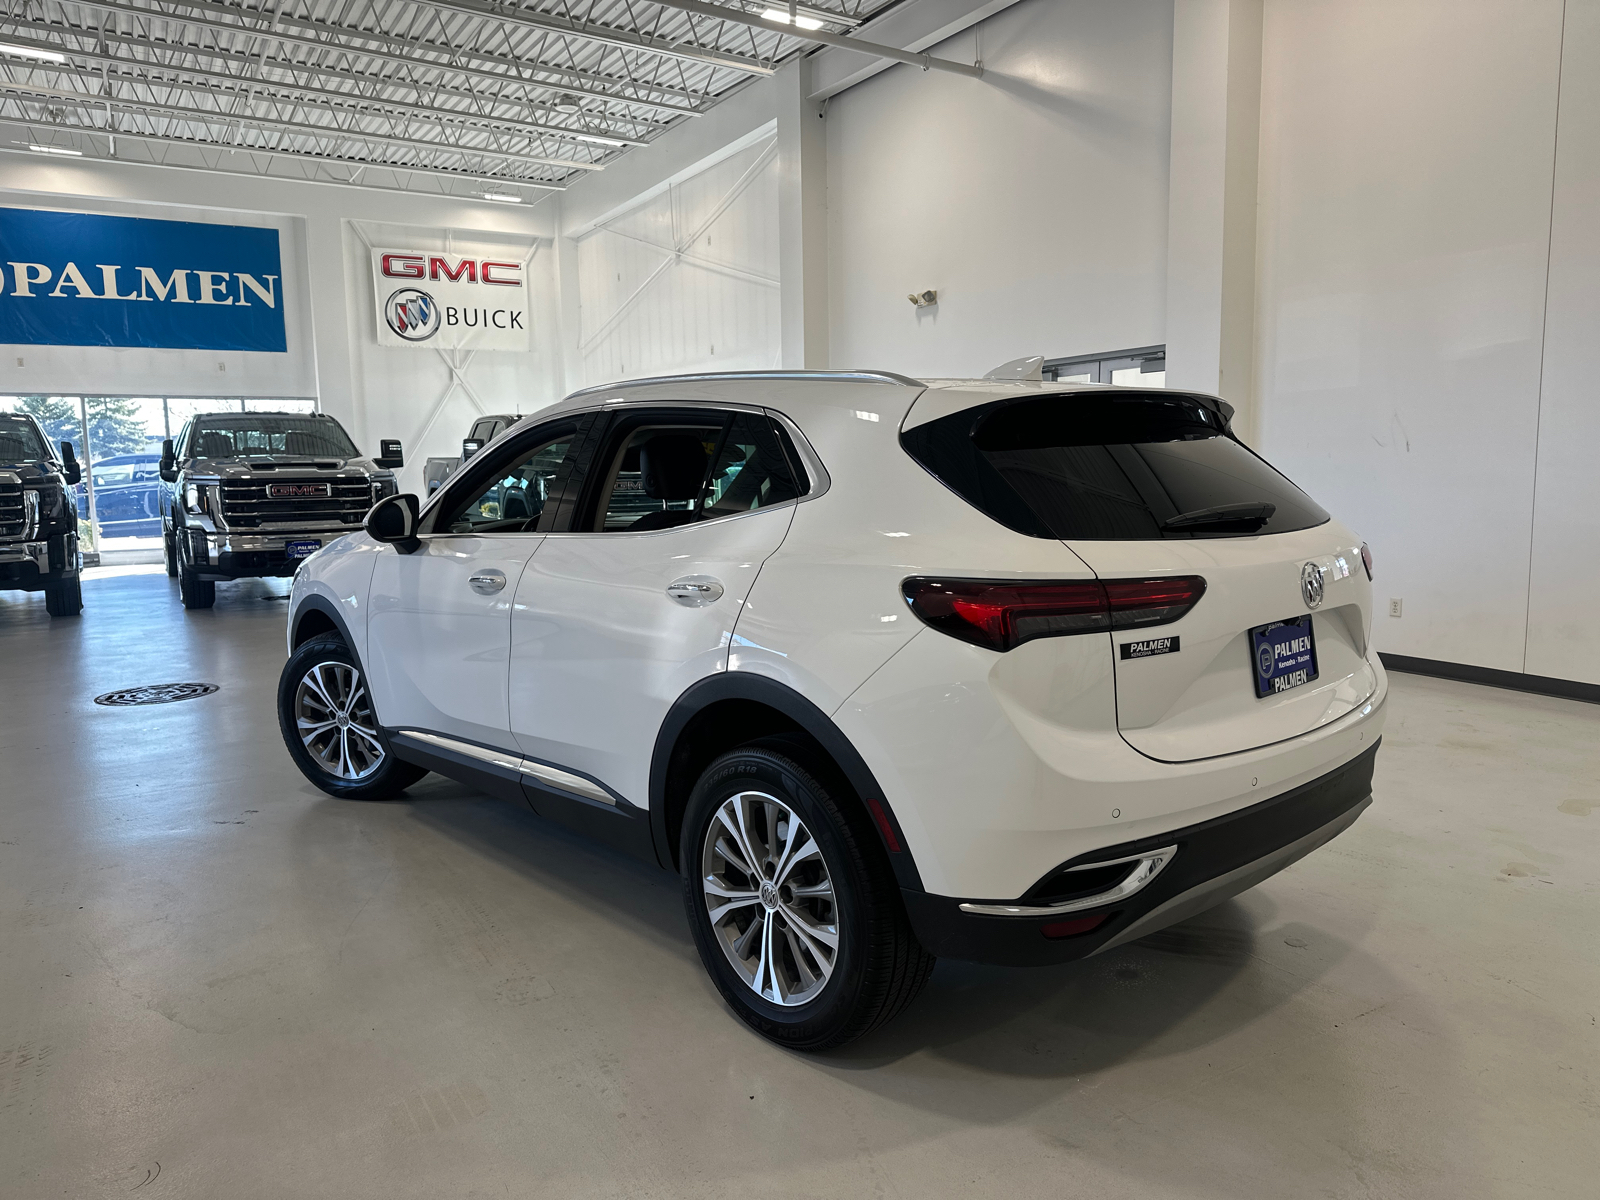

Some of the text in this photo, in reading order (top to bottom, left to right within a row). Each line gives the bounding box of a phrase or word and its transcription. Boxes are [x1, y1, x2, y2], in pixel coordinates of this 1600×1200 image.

[381, 252, 522, 288] GMC
[6, 261, 279, 309] PALMEN
[446, 306, 524, 330] BUICK
[272, 486, 326, 496] GMC
[614, 481, 643, 490] GM
[1130, 638, 1171, 653] PALMEN
[1131, 650, 1152, 658] KENOSHA
[1154, 647, 1170, 655] RACINE
[1274, 635, 1311, 659] PALMEN
[1278, 658, 1296, 669] Kenosha
[1297, 654, 1310, 663] Racine
[1274, 669, 1307, 693] PALMEN
